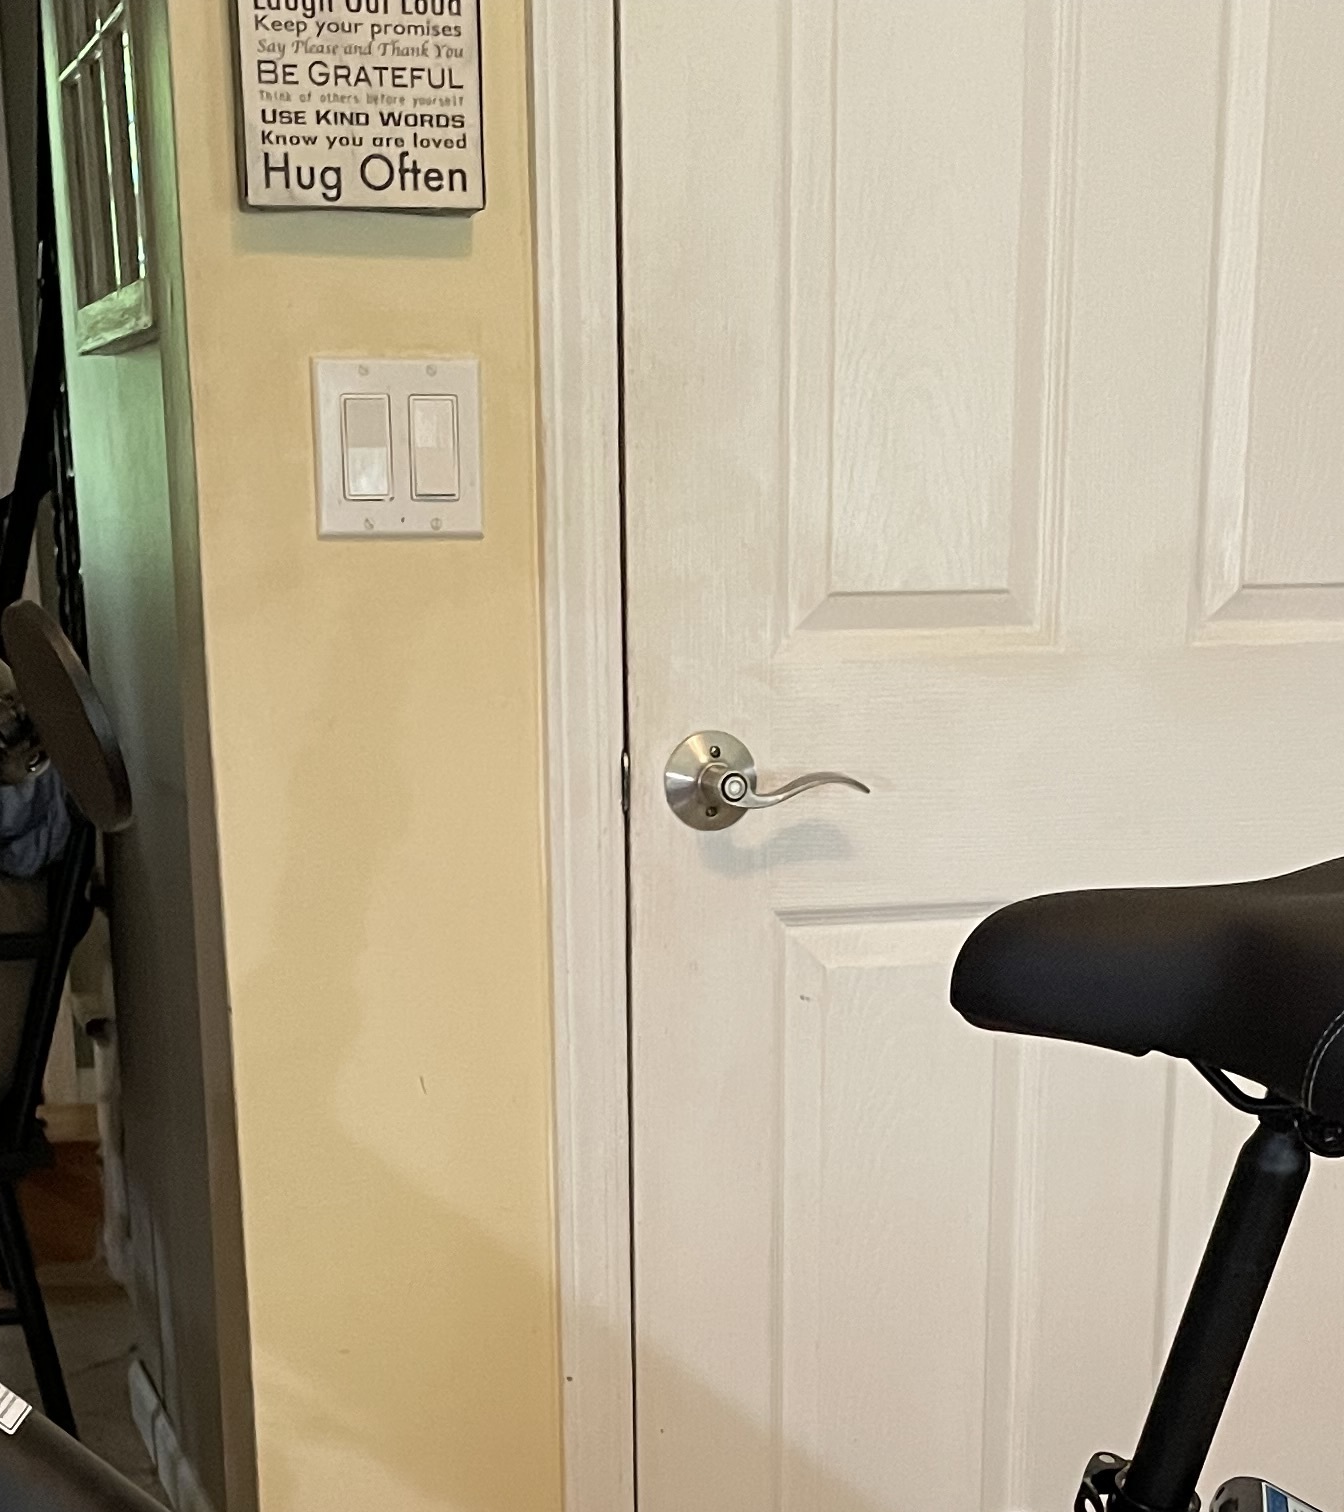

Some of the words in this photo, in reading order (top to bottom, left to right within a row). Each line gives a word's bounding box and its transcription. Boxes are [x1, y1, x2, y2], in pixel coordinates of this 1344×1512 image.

[254, 14, 307, 37] Keep
[315, 21, 364, 37] your
[371, 19, 462, 39] promises
[257, 39, 286, 59] Say
[291, 37, 338, 55] Please
[343, 41, 372, 56] and
[378, 42, 430, 58] Thank
[435, 44, 464, 59] You
[257, 60, 299, 85] BE
[308, 60, 464, 89] GRATEFUL
[261, 108, 307, 125] USE
[315, 109, 369, 127] KIND
[379, 111, 465, 129] WORDS
[261, 130, 318, 146] Know
[326, 134, 364, 150] you
[372, 135, 405, 148] are
[413, 132, 467, 149] loved
[263, 151, 342, 202] Hug
[360, 150, 468, 192] Often
